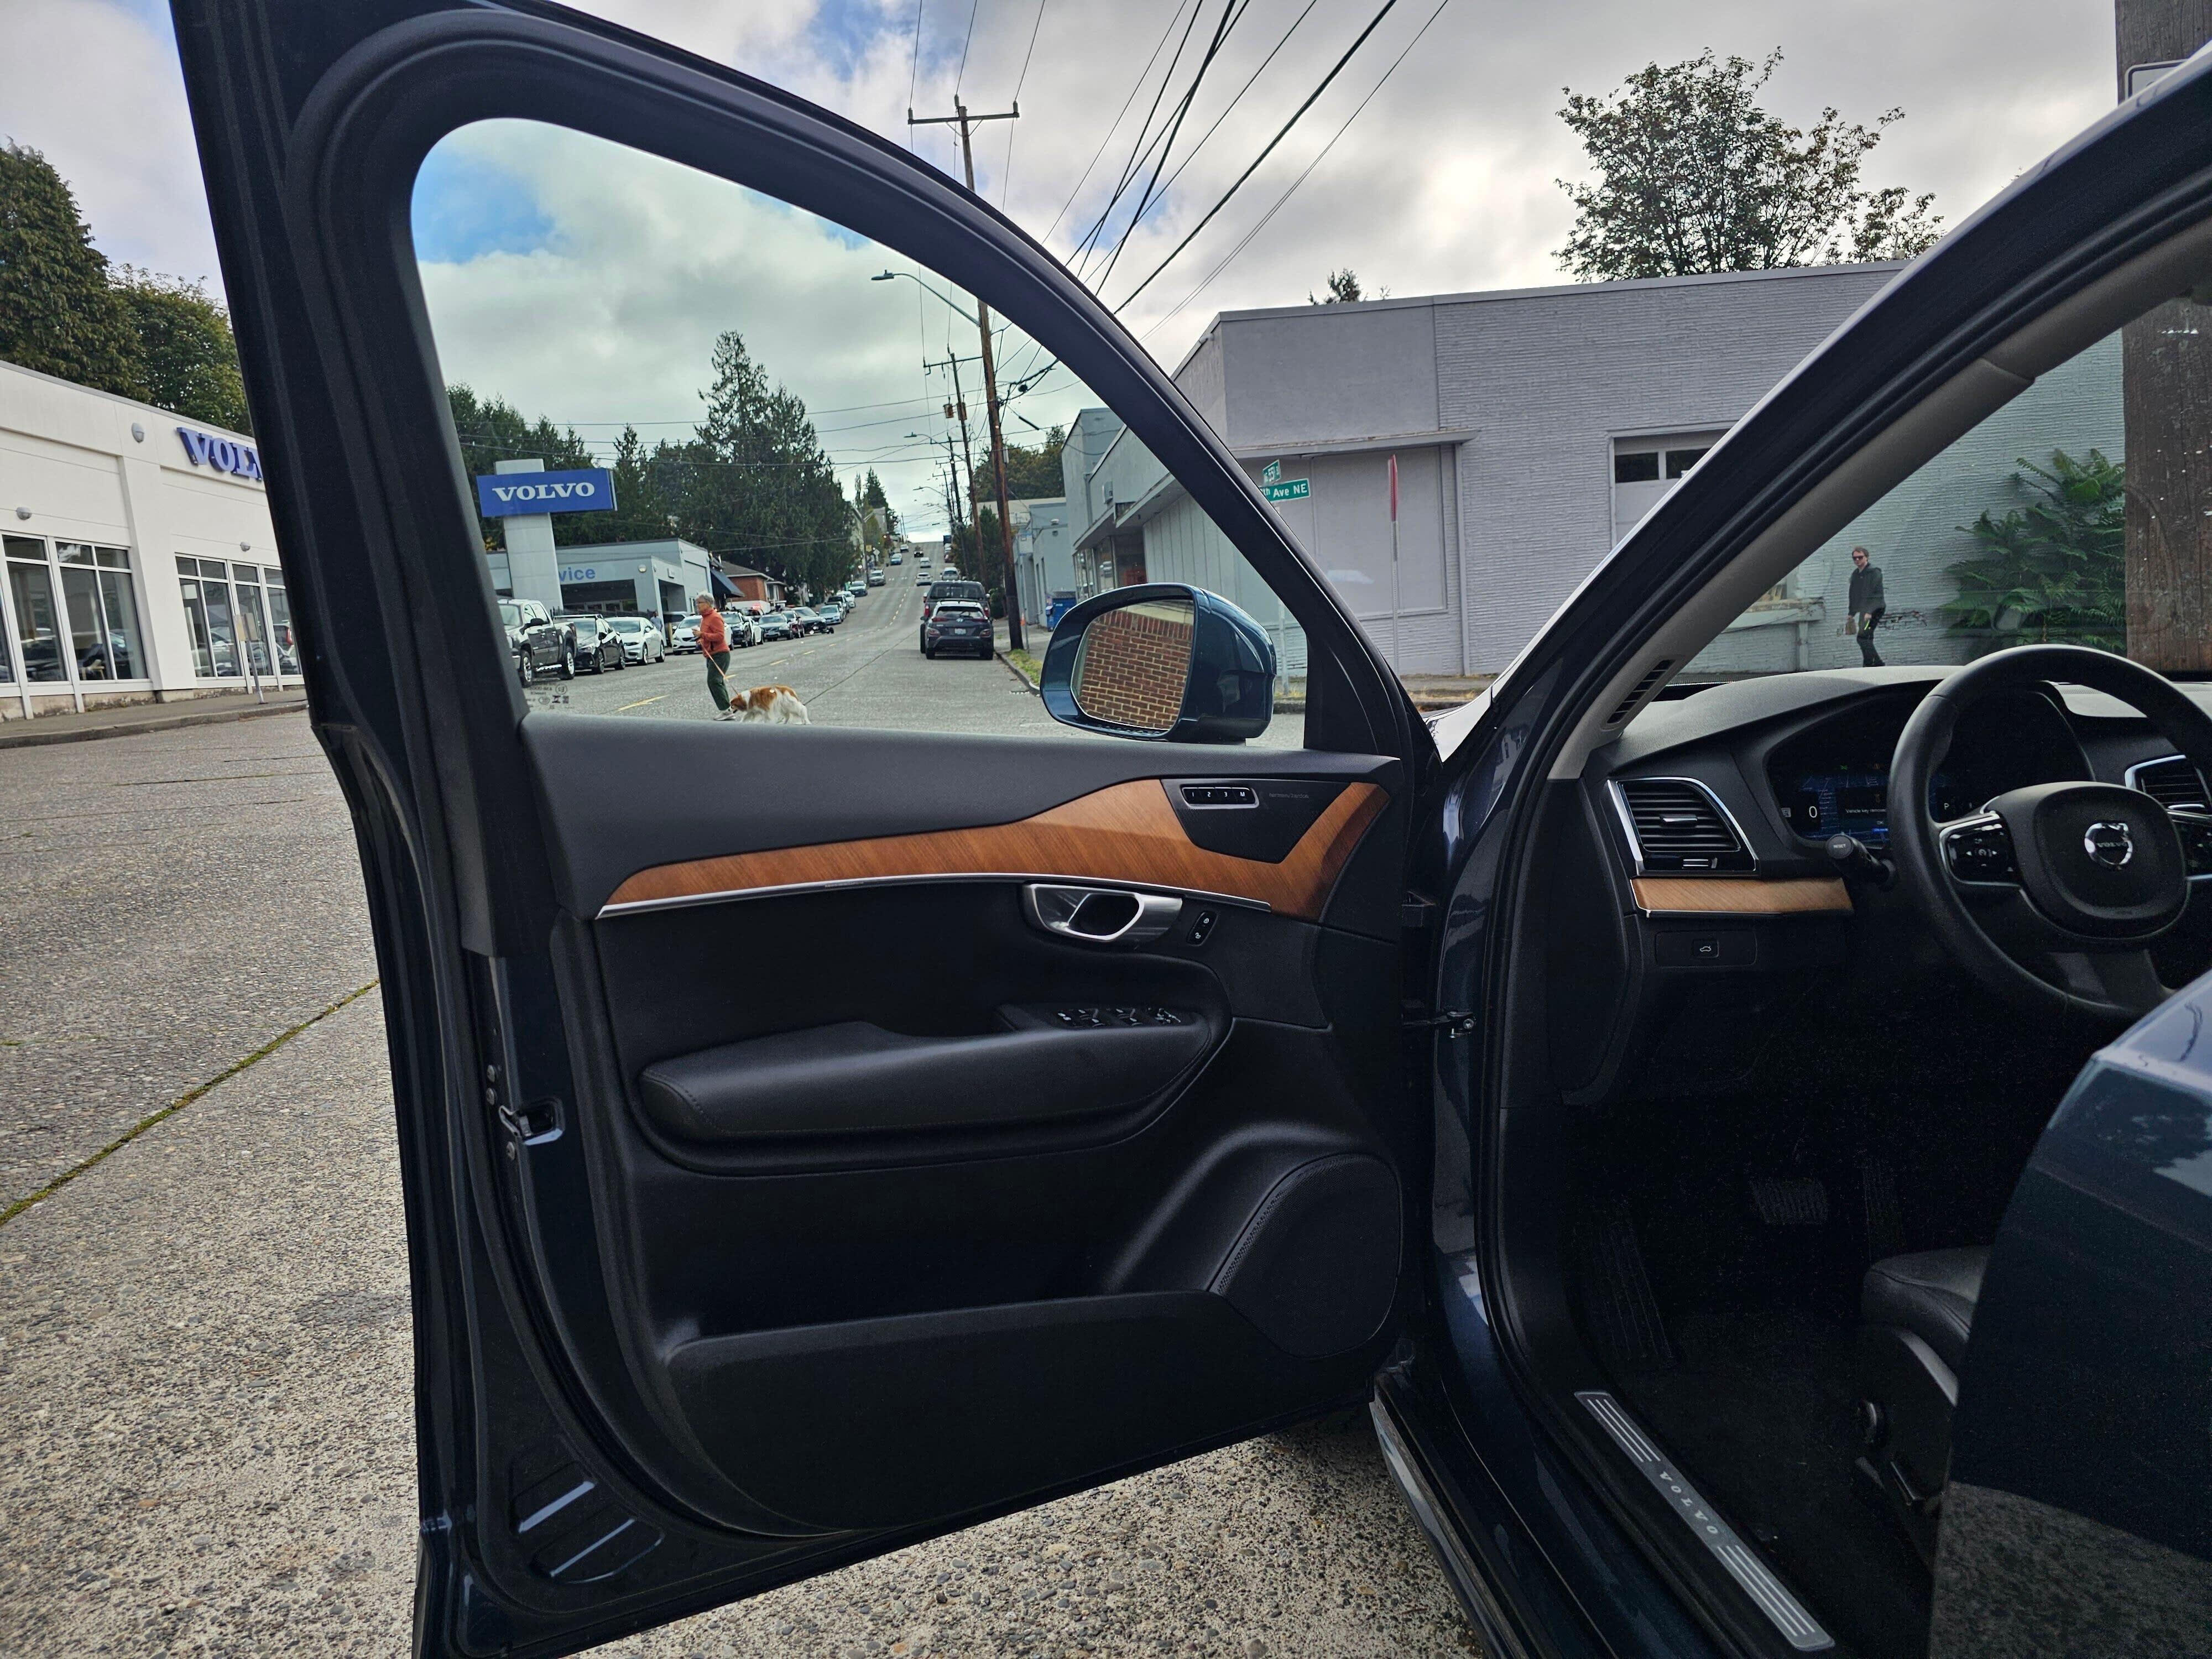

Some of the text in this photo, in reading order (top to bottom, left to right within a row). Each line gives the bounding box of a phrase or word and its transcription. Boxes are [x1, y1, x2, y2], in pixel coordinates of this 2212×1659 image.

[492, 482, 595, 502] VOLVO
[1273, 488, 1290, 498] Ave
[1293, 483, 1307, 494] NE
[1660, 1471, 1718, 1534] VOLVO
